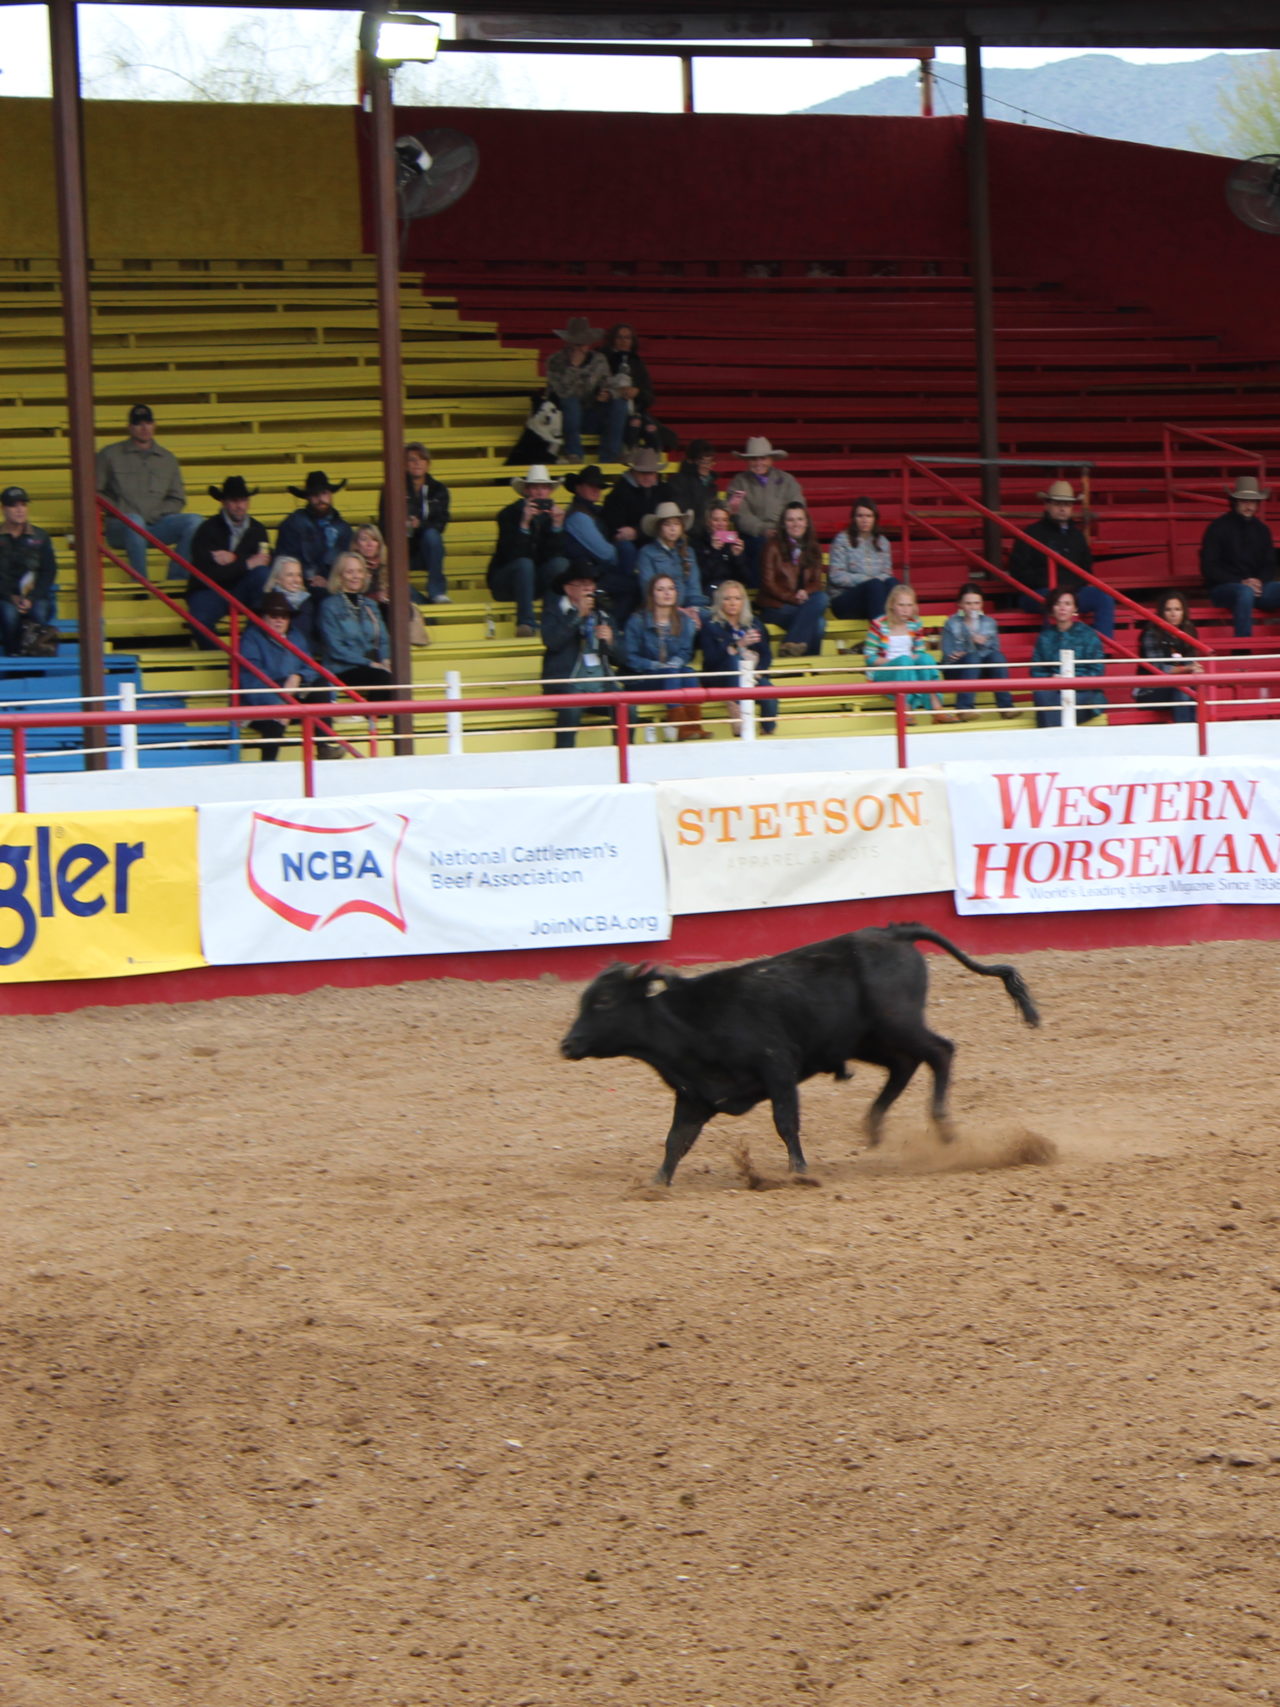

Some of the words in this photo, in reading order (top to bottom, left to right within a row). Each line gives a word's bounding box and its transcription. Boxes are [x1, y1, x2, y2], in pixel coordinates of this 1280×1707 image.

[991, 772, 1261, 829] WESTERN
[675, 791, 924, 846] STETSON
[280, 849, 384, 882] NCBA
[429, 846, 507, 867] National
[511, 841, 618, 864] Cattlemen's
[726, 852, 805, 870] APPAREL
[811, 850, 820, 864] &
[827, 845, 881, 865] BOOTS
[430, 873, 472, 890] Beef
[477, 869, 584, 888] Association
[1027, 886, 1076, 899] World's
[1080, 885, 1125, 899] Leading
[1130, 882, 1167, 894] Horse
[1219, 878, 1250, 891] Since
[528, 914, 660, 936] JoinNCBA.org
